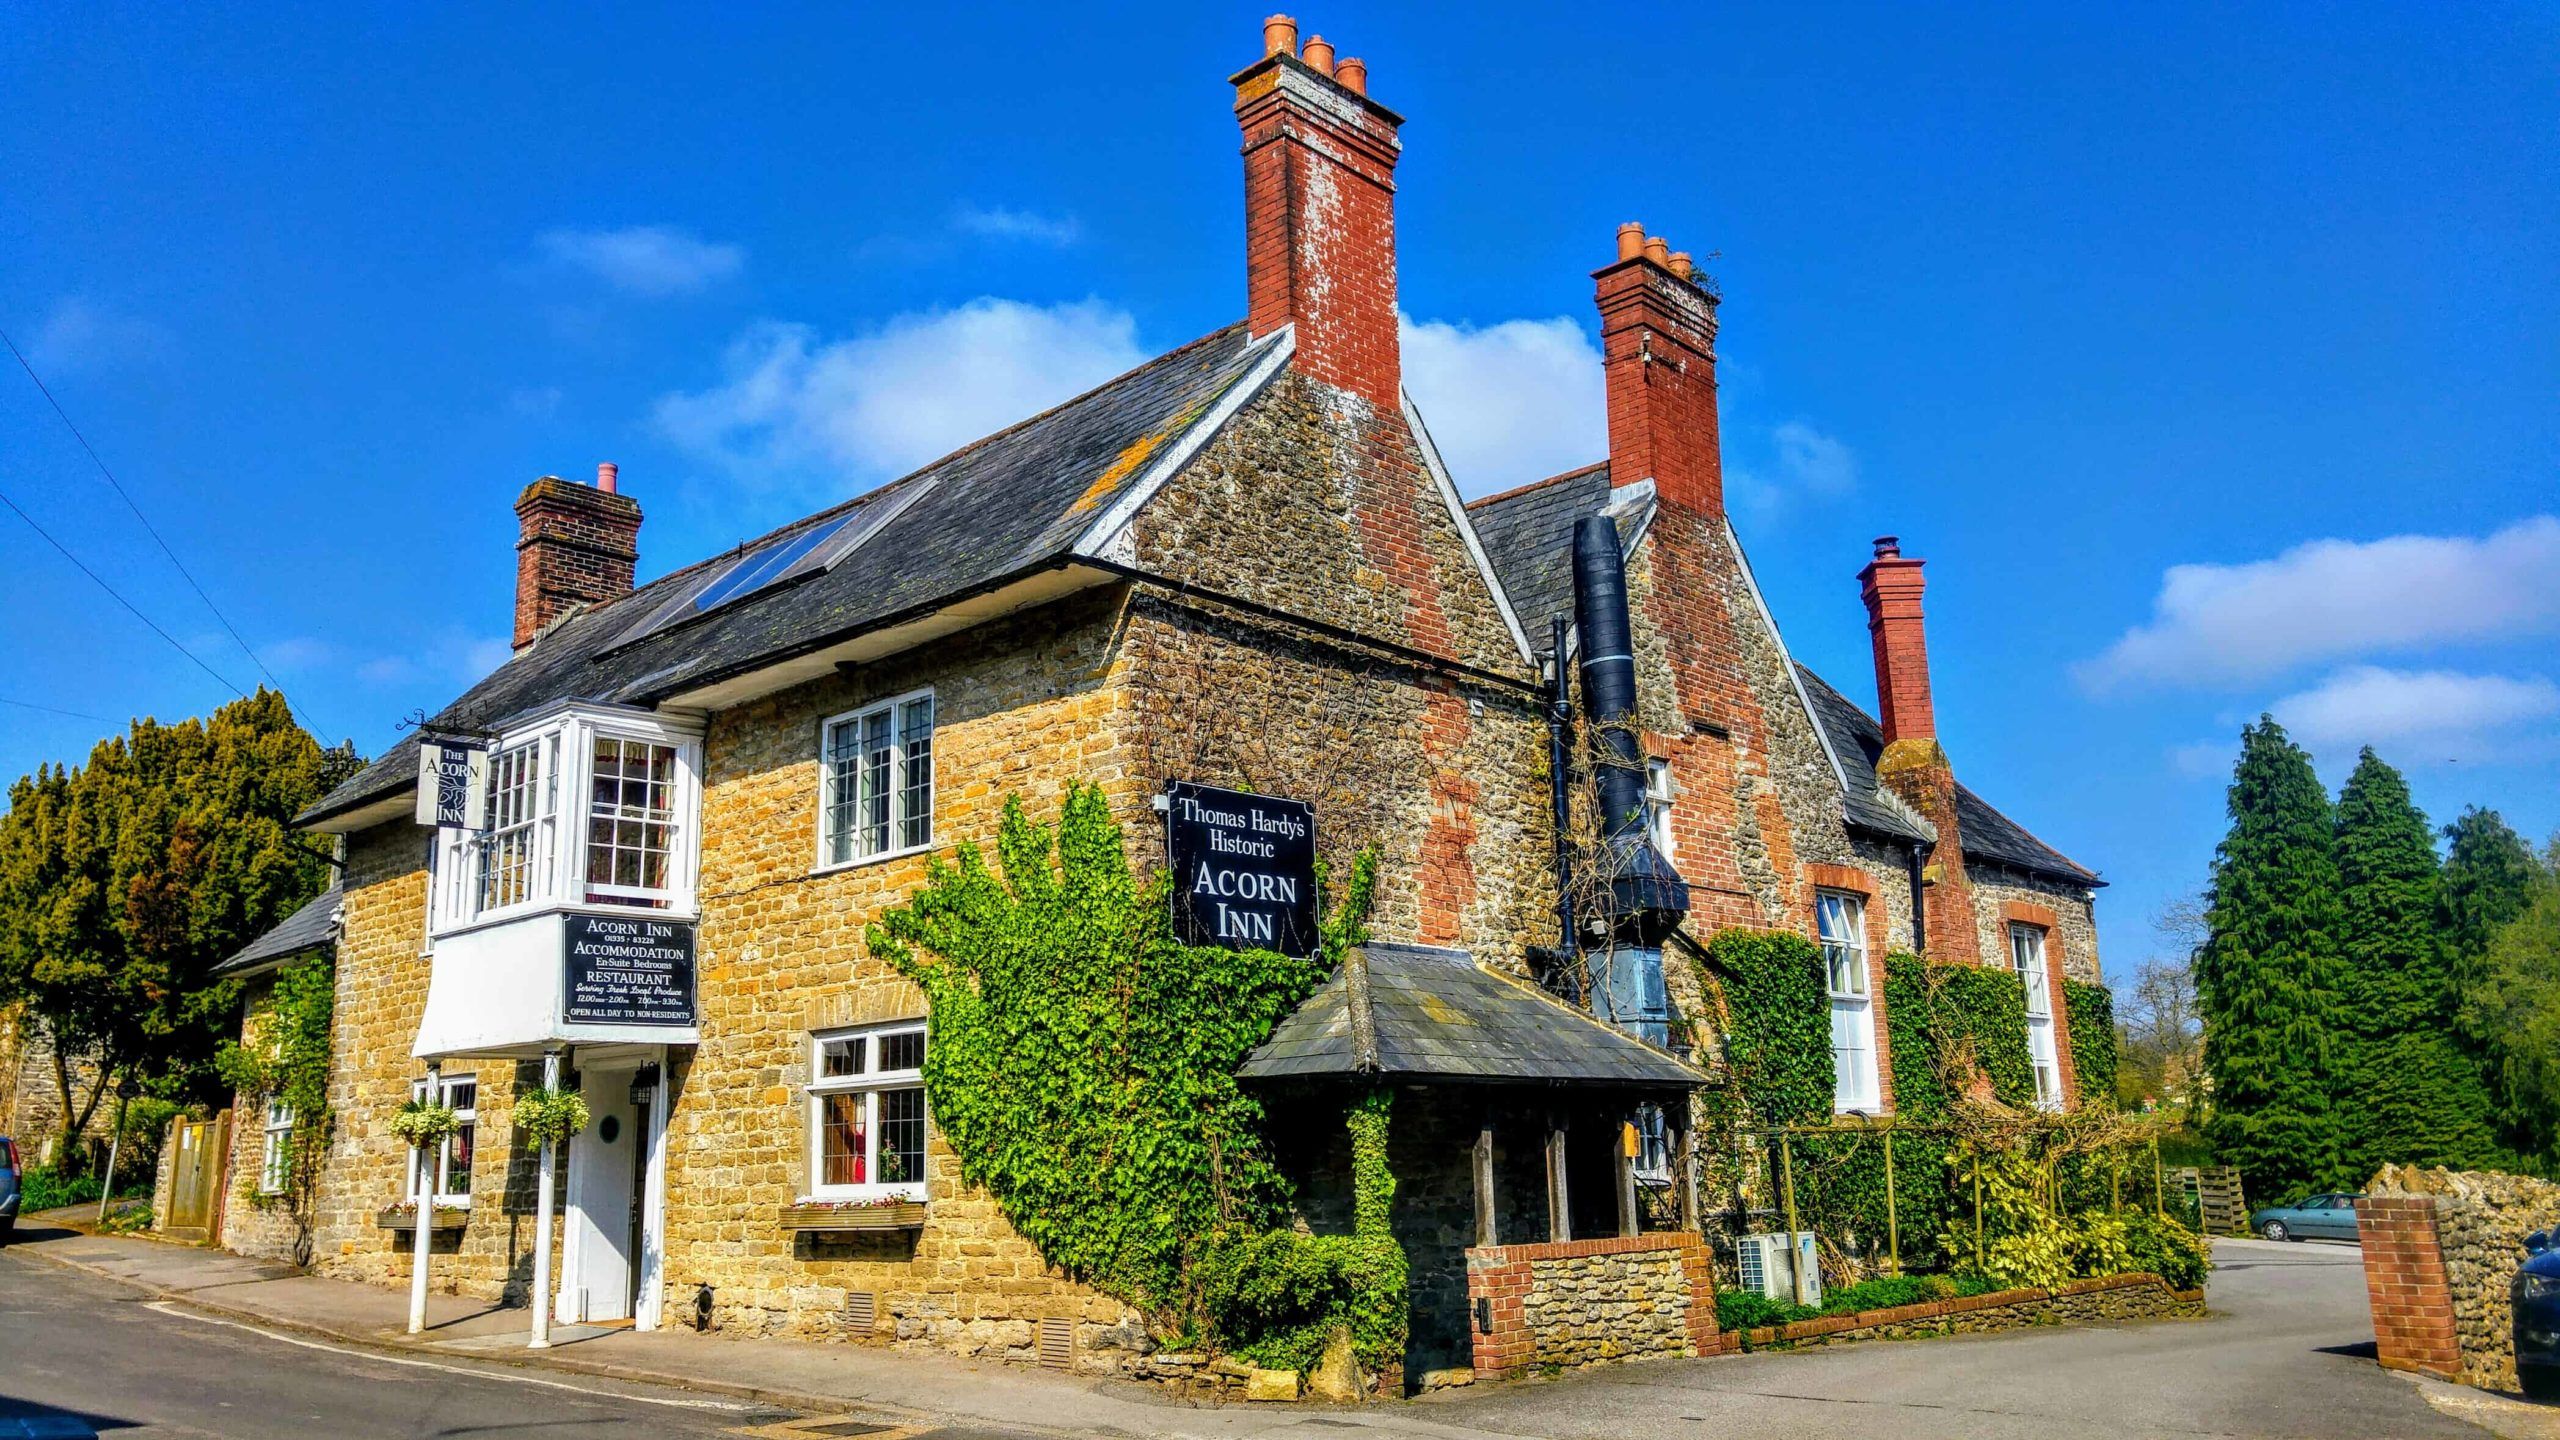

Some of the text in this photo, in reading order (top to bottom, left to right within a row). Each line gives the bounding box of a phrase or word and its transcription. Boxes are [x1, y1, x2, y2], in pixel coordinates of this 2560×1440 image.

[444, 749, 464, 761] THE
[425, 757, 479, 778] ACORN
[438, 804, 465, 822] INN
[1179, 797, 1305, 840] Thomas Hardy's
[1209, 828, 1275, 858] Historic
[1193, 860, 1297, 903] ACORN
[586, 918, 672, 937] ACORN INN
[1216, 902, 1273, 941] INN
[573, 940, 685, 960] ACCOMMODATION
[595, 957, 673, 970] En-Suite Bedrooms
[586, 970, 673, 986] RESTAURANT
[575, 982, 683, 996] Serving Fresh Local Produce
[570, 1008, 690, 1019] OPEN ALL DAY TO NON-RESIDENTS
